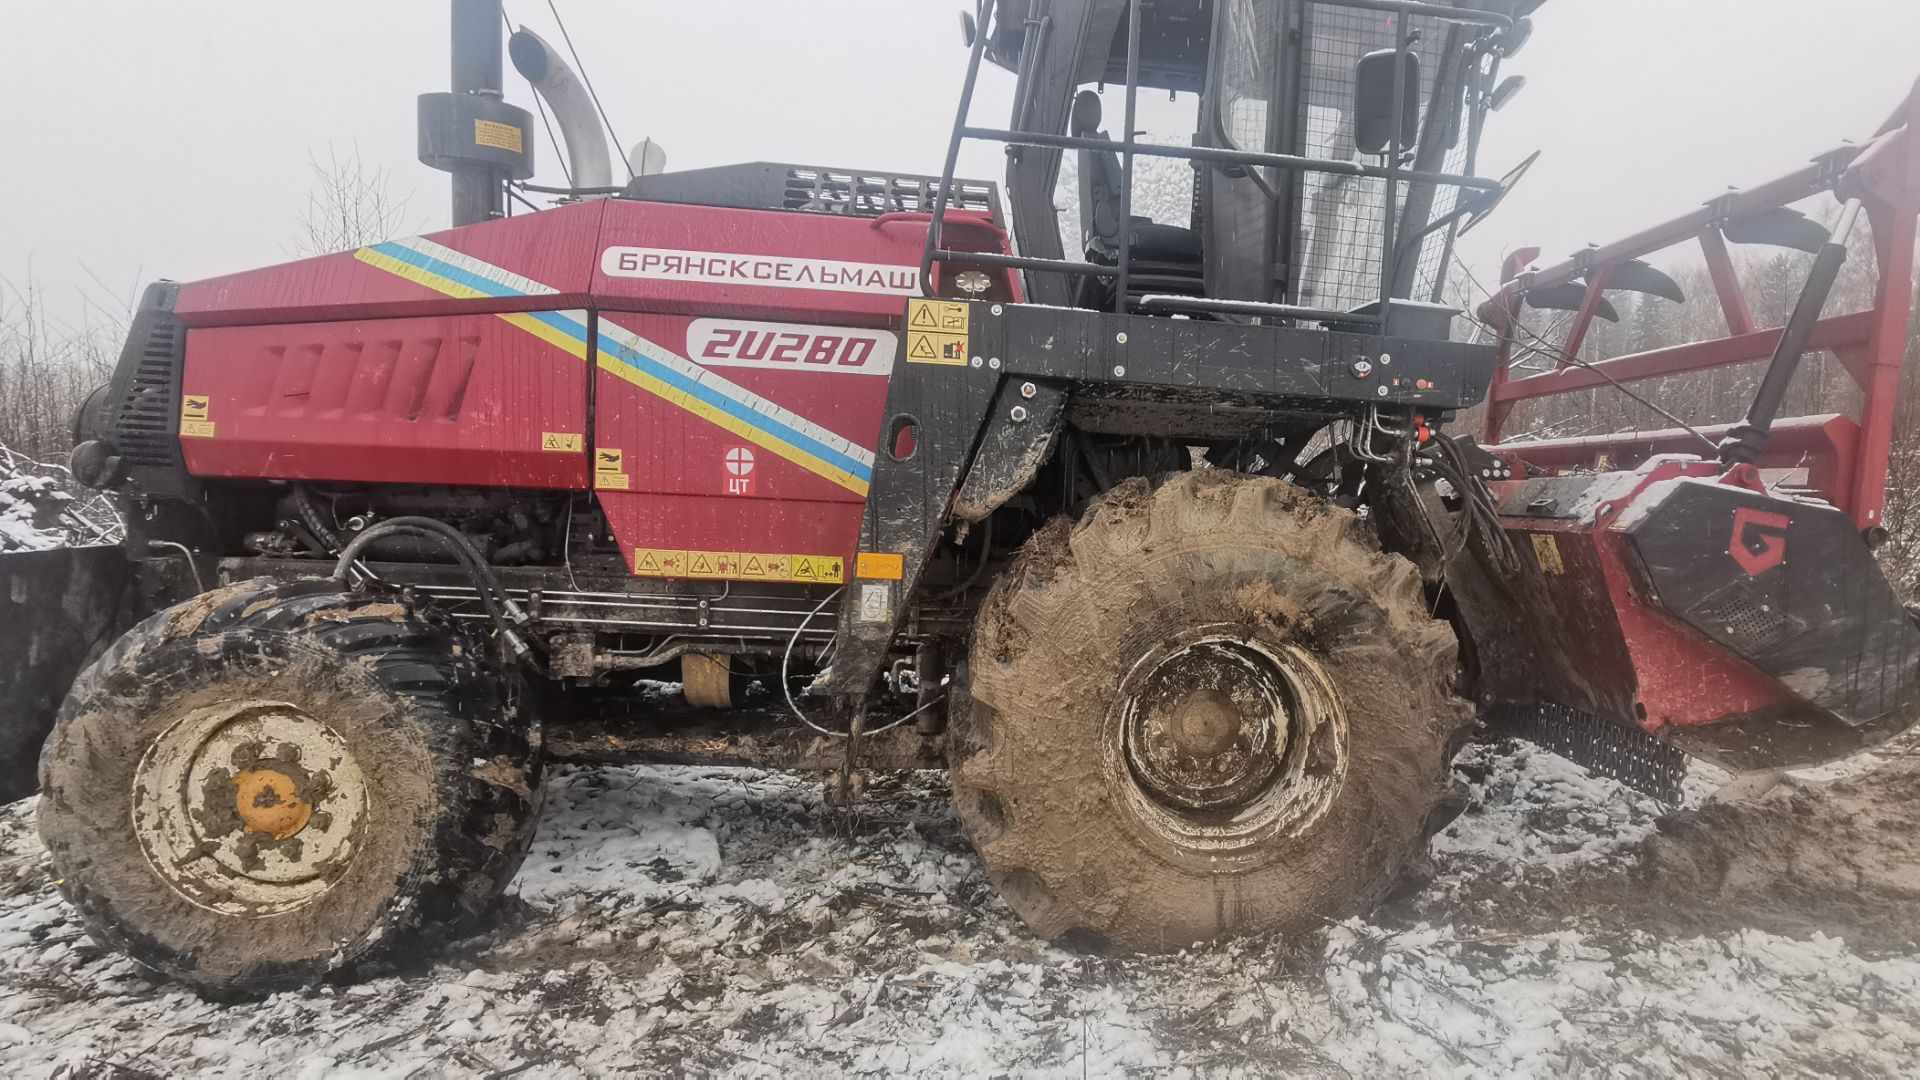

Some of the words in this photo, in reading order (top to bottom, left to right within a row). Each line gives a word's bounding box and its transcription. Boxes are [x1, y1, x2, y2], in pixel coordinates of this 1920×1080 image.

[618, 253, 916, 290] БРЯНСКСЕЛЬМАШ
[702, 328, 877, 367] 2U280
[729, 478, 750, 495] ЦТ
